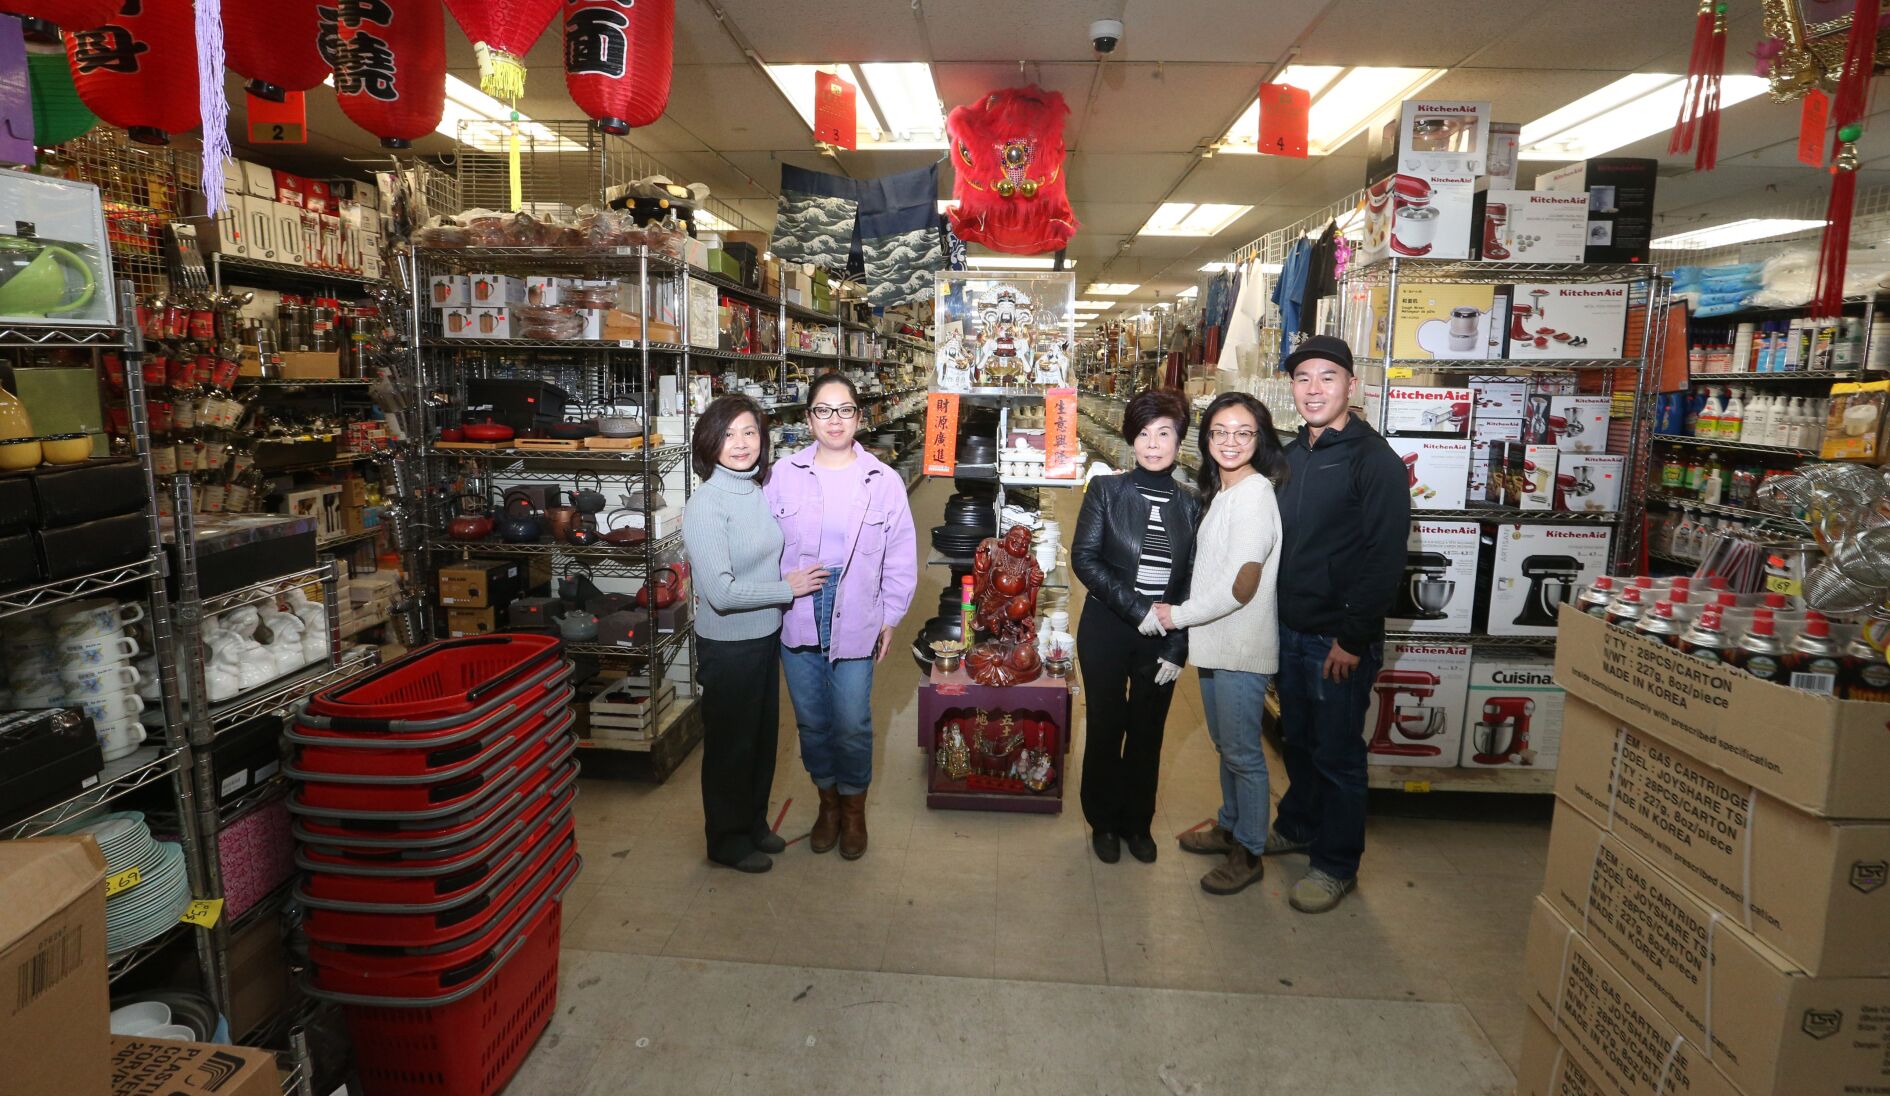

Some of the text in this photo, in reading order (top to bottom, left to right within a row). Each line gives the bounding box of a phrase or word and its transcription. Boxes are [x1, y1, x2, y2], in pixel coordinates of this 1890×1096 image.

[565, 0, 634, 78] 面
[1418, 104, 1476, 112] KitchenAid
[272, 125, 284, 140] 2
[832, 129, 840, 142] 3
[1276, 136, 1284, 150] 4
[1430, 176, 1472, 184] KitchenAid
[1530, 196, 1586, 205] KitchenAid
[1560, 288, 1623, 298] KitchenAid
[1388, 390, 1470, 401] KitchenAid
[933, 398, 950, 464] 財源廣進
[1054, 400, 1068, 465] 生意興隆
[1486, 420, 1520, 428] KitchenAid
[1412, 525, 1476, 535] KitchenAid
[1546, 530, 1607, 539] KitchenAid
[1395, 645, 1467, 656] KitchenAid
[1637, 646, 1732, 693] 28PCS/CARTON
[1492, 671, 1555, 685] Cuisina
[1602, 661, 1688, 710] MADE IN KOREA
[1668, 675, 1730, 709] 8oz/piece
[1653, 708, 1670, 722] with
[1671, 716, 1718, 745] prescribed
[1616, 728, 1641, 750] IEM
[1649, 748, 1672, 768] GAS
[1674, 762, 1750, 812] CARTRIDGE
[1656, 770, 1720, 814] JOYSHARE
[1638, 802, 1650, 818] IN
[1652, 811, 1692, 847] KOREA
[1645, 777, 1737, 840] 28PCS/CARTON
[1674, 811, 1734, 855] 8oz/piece
[1600, 844, 1619, 868] TEM
[1626, 867, 1647, 890] GAS
[1596, 857, 1626, 890] MODEL
[1634, 888, 1690, 944] JOYSHARE
[1590, 896, 1614, 925] MADE
[1616, 920, 1626, 936] IN
[1628, 928, 1663, 970] KOREA
[1622, 894, 1702, 972] 28PCS/CARTON
[1574, 950, 1594, 978] ITEM
[1601, 980, 1621, 1004] GAS
[1648, 934, 1698, 984] 8oz/piece
[1572, 964, 1600, 1000] MODEL
[1608, 1004, 1664, 1064] JOYSHARE
[111, 1044, 163, 1087] FOR/P
[1564, 1001, 1588, 1033] MADE
[1590, 1031, 1600, 1046] IN
[1602, 1042, 1636, 1086] KOREA
[1596, 1007, 1676, 1092] 28PCS/CARTN
[137, 1048, 201, 1093] PLASTI
[1621, 1048, 1662, 1096] 8oz/pie
